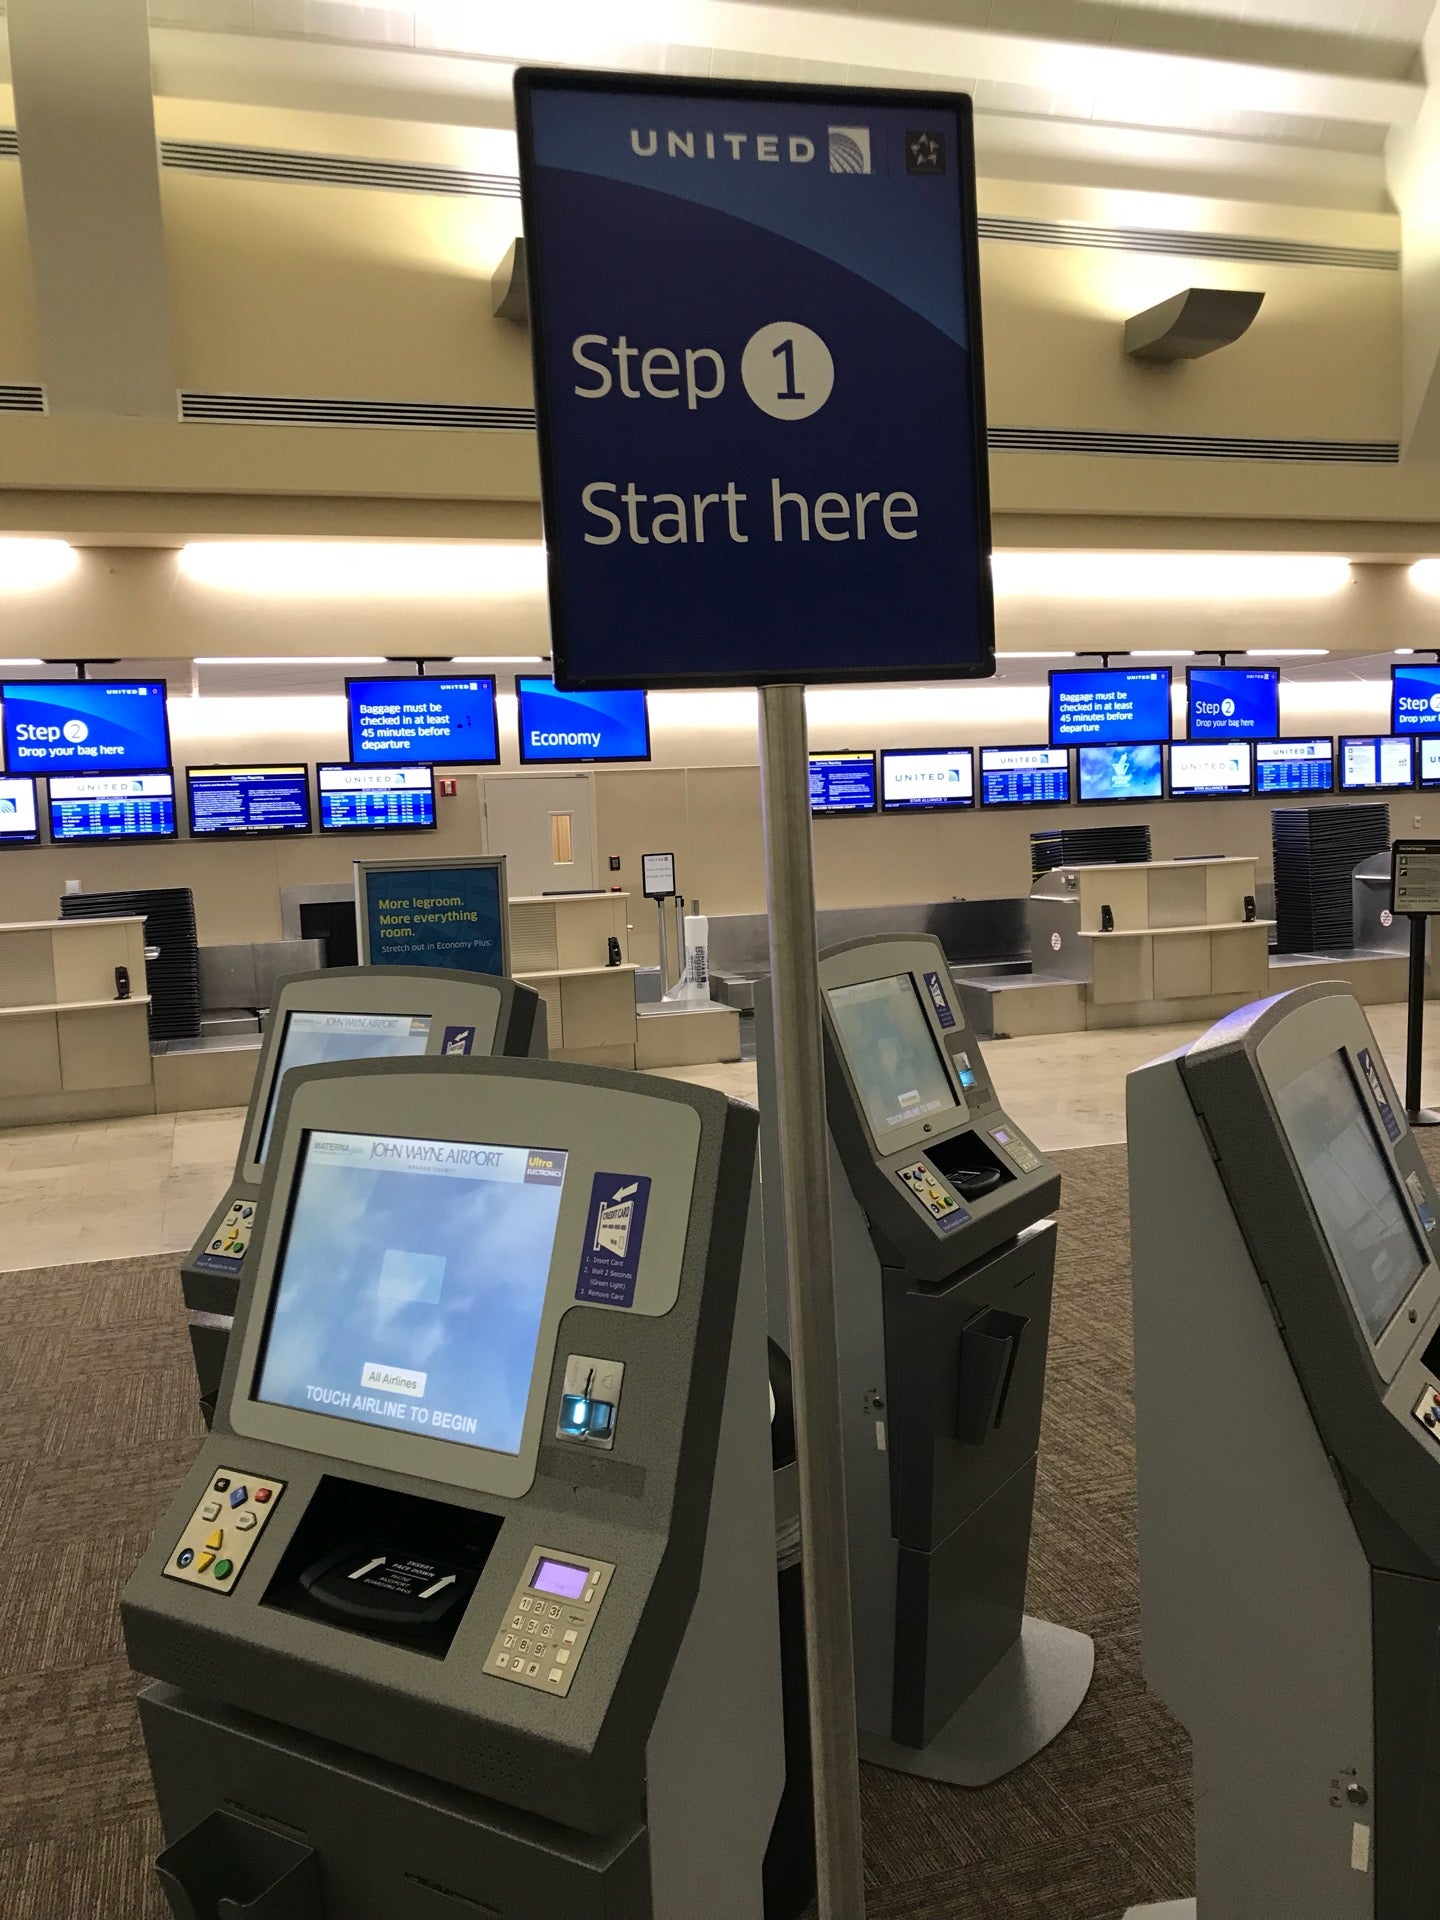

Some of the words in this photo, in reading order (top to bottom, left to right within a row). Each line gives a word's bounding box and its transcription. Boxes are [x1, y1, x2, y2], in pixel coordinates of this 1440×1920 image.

[630, 128, 816, 164] UNITED
[571, 333, 726, 410] Step
[771, 338, 806, 401] 1
[580, 480, 749, 546] Start
[771, 478, 919, 542] here
[1059, 693, 1094, 703] Baggage
[1095, 692, 1116, 701] must
[1116, 691, 1128, 700] be
[359, 704, 401, 715] Baggage
[402, 703, 428, 713] must
[429, 702, 443, 713] be
[1059, 702, 1093, 713] checked
[1094, 702, 1103, 711] in
[1103, 702, 1113, 711] at
[1113, 701, 1133, 710] least
[1195, 700, 1220, 716] Step
[1398, 696, 1429, 712] Step
[360, 715, 401, 726] checked
[402, 715, 413, 725] in
[414, 715, 425, 725] at
[426, 714, 450, 724] least
[1060, 714, 1071, 723] 45
[1072, 713, 1105, 722] minutes
[1106, 712, 1133, 721] before
[1196, 718, 1212, 728] Drop
[1212, 719, 1228, 729] your
[1227, 718, 1240, 728] bag
[1240, 718, 1255, 727] here
[1399, 714, 1419, 724] Drop
[1419, 714, 1437, 724] your
[15, 722, 61, 743] Step
[361, 728, 375, 738] 45
[376, 727, 417, 737] minutes
[417, 726, 451, 736] before
[1059, 723, 1100, 734] departure
[361, 739, 411, 751] departure
[530, 730, 602, 748] Economy
[18, 746, 47, 758] Drop
[49, 746, 75, 758] your
[77, 745, 99, 757] bag
[99, 744, 125, 755] here
[1000, 756, 1038, 764] UNITED
[1181, 762, 1226, 771] UNITED
[345, 776, 392, 784] UNITED
[895, 772, 945, 782] UNITED
[77, 783, 128, 792] UNITED
[378, 898, 410, 910] More
[412, 897, 465, 910] legroom.
[379, 914, 411, 926] More
[413, 910, 478, 924] everything
[380, 927, 416, 939] room.
[381, 944, 410, 953] Stretch
[411, 943, 425, 951] out
[426, 942, 435, 950] in
[436, 941, 472, 950] Economy
[369, 1142, 404, 1160] JOHN
[404, 1144, 445, 1163] WAYNE
[445, 1148, 504, 1168] AIRPORT
[528, 1156, 553, 1168] Ultra
[527, 1168, 562, 1178] ELECTRONICS
[602, 1210, 617, 1220] CREDIT
[617, 1206, 630, 1218] CARD
[593, 1257, 609, 1265] Insert
[610, 1258, 624, 1267] Card
[592, 1268, 604, 1276] Wait
[610, 1270, 632, 1280] Seconds
[588, 1289, 610, 1299] Remove
[611, 1292, 624, 1301] Card
[368, 1370, 381, 1383] All
[382, 1373, 417, 1390] Airlines
[306, 1384, 352, 1408] TOUCH
[352, 1395, 407, 1420] AIRLINE
[410, 1405, 429, 1424] TO
[431, 1410, 478, 1434] BEGIN
[391, 1563, 412, 1571] FACE
[410, 1568, 436, 1578] DOWN
[406, 1560, 435, 1571] INSERT
